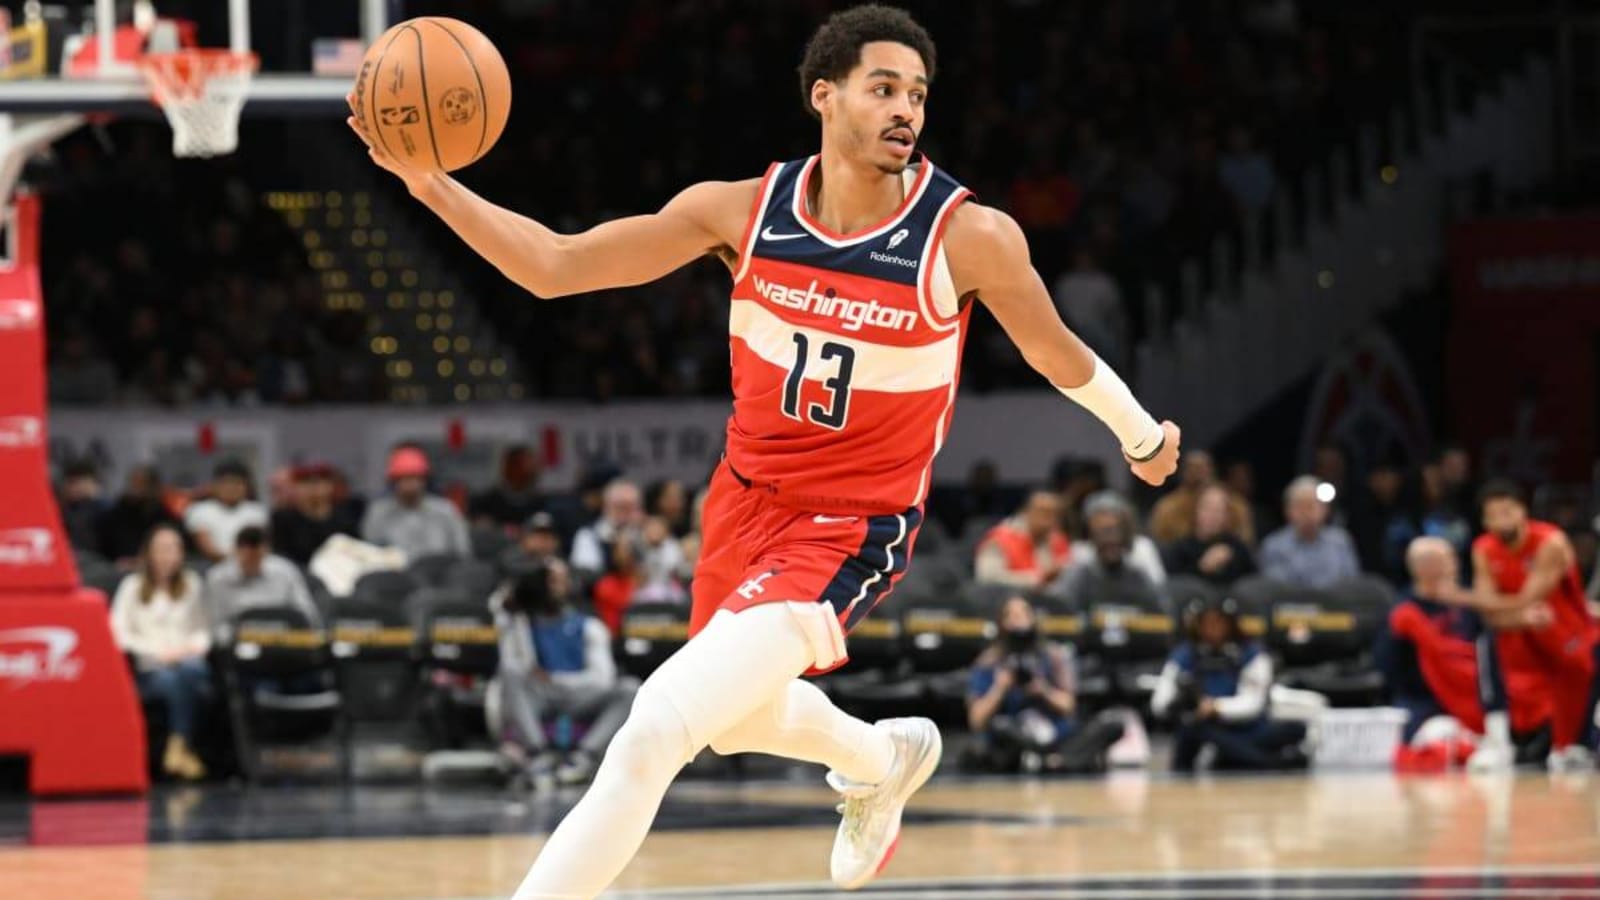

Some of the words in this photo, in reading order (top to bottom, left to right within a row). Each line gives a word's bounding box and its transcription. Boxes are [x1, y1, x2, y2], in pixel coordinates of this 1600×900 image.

[870, 251, 917, 268] Robinhood
[752, 273, 918, 332] washington
[780, 331, 856, 431] 13
